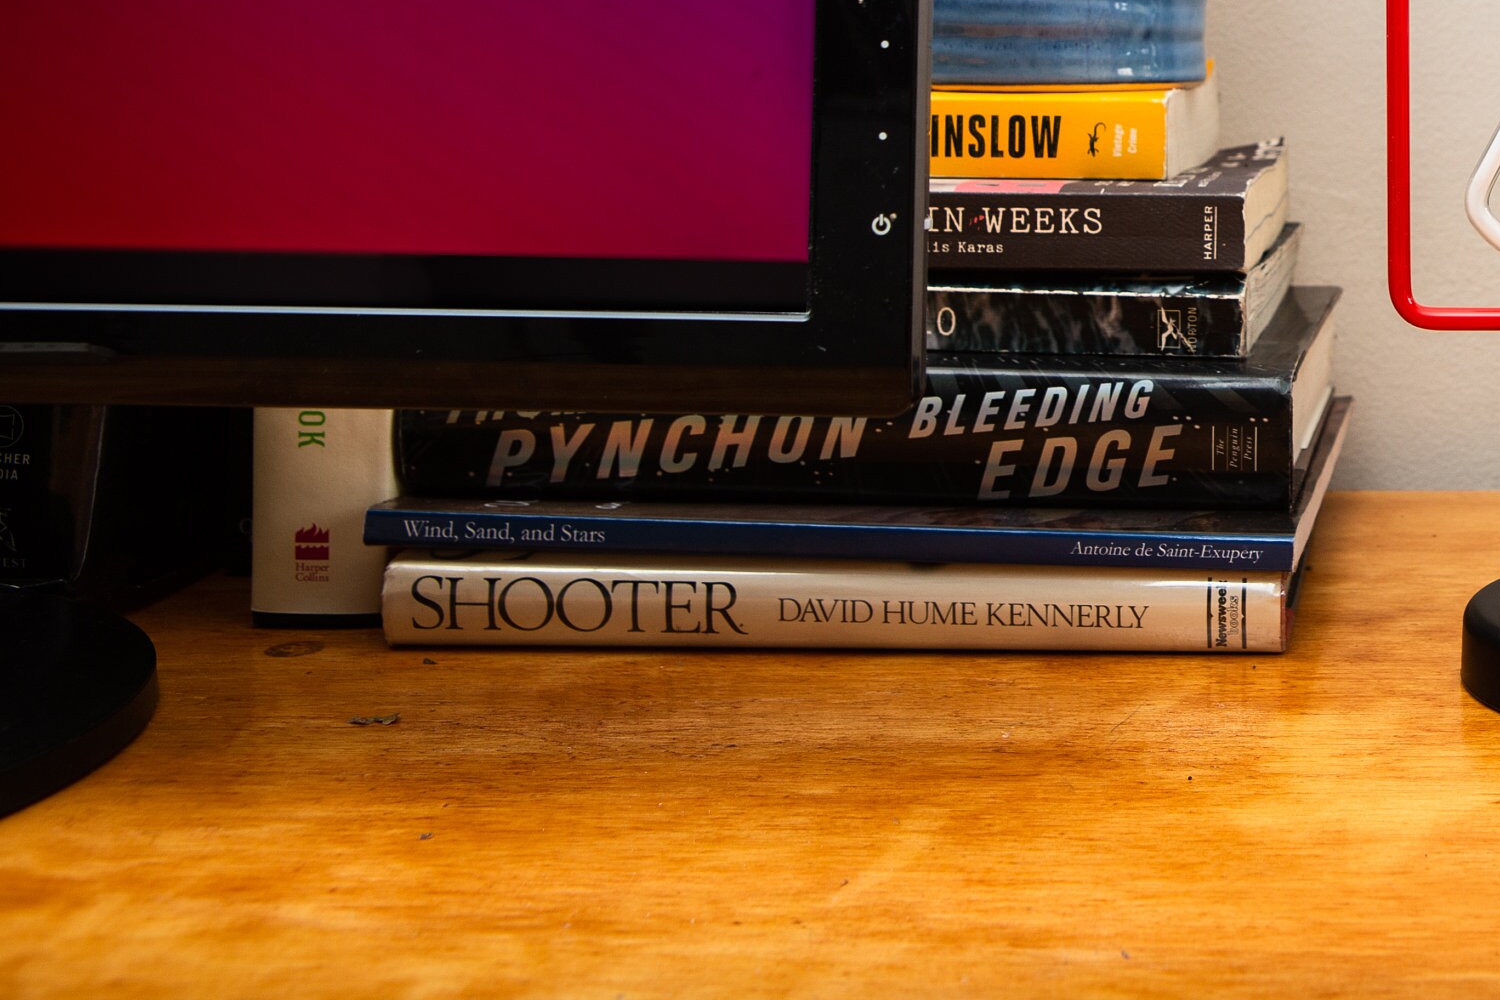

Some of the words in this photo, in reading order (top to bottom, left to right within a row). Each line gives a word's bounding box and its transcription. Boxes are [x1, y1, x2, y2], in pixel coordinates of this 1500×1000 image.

[931, 114, 1062, 158] INSLOW
[982, 207, 1103, 234] WEEKS
[1203, 205, 1213, 260] HARPER
[958, 241, 1004, 253] Karas
[908, 379, 1154, 440] BLEEDING
[486, 414, 869, 487] PYNCHON
[977, 423, 1183, 500] EDGE
[1229, 428, 1240, 468] Penguin
[403, 519, 459, 541] Wind,
[464, 521, 515, 543] Sand,
[521, 523, 555, 541] and
[560, 524, 606, 543] Stars
[1070, 541, 1131, 556] Antoine
[1135, 542, 1153, 557] de
[295, 562, 329, 574] Harper
[295, 572, 329, 582] Collins
[411, 575, 749, 635] SHOOTER
[777, 597, 873, 624] DAVID
[882, 600, 978, 625] HUME
[985, 602, 1149, 629] KENNERLY
[1227, 595, 1239, 636] books
